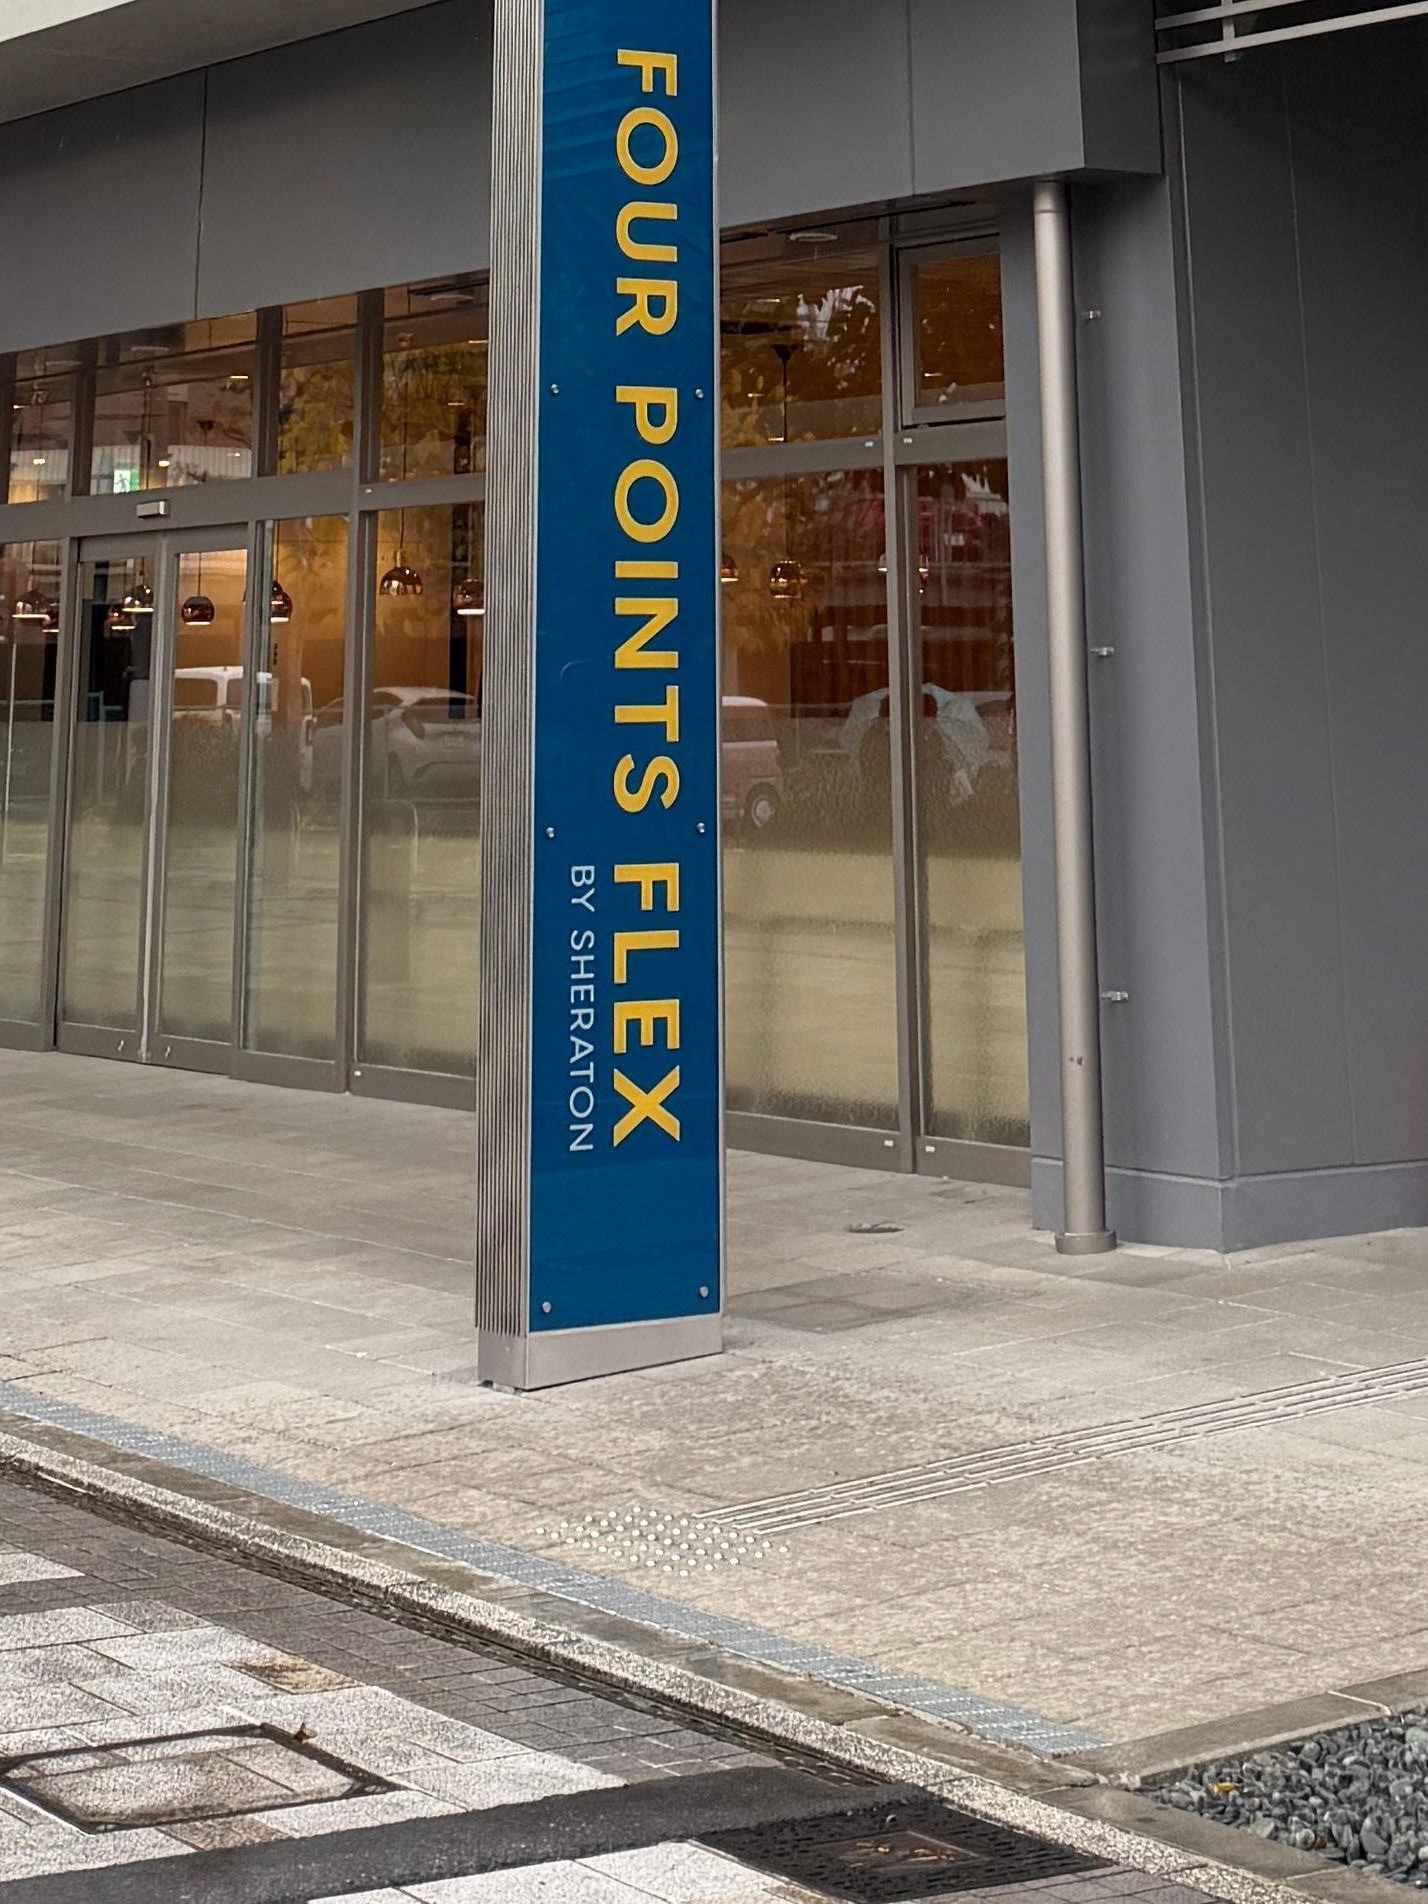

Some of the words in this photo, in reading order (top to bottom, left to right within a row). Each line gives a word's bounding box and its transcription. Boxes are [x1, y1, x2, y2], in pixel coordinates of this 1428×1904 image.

[616, 49, 678, 336] FOUR
[613, 386, 680, 814] POINTS
[571, 865, 595, 912] BY
[613, 862, 680, 1146] FLEX
[569, 930, 595, 1151] SHERATON
